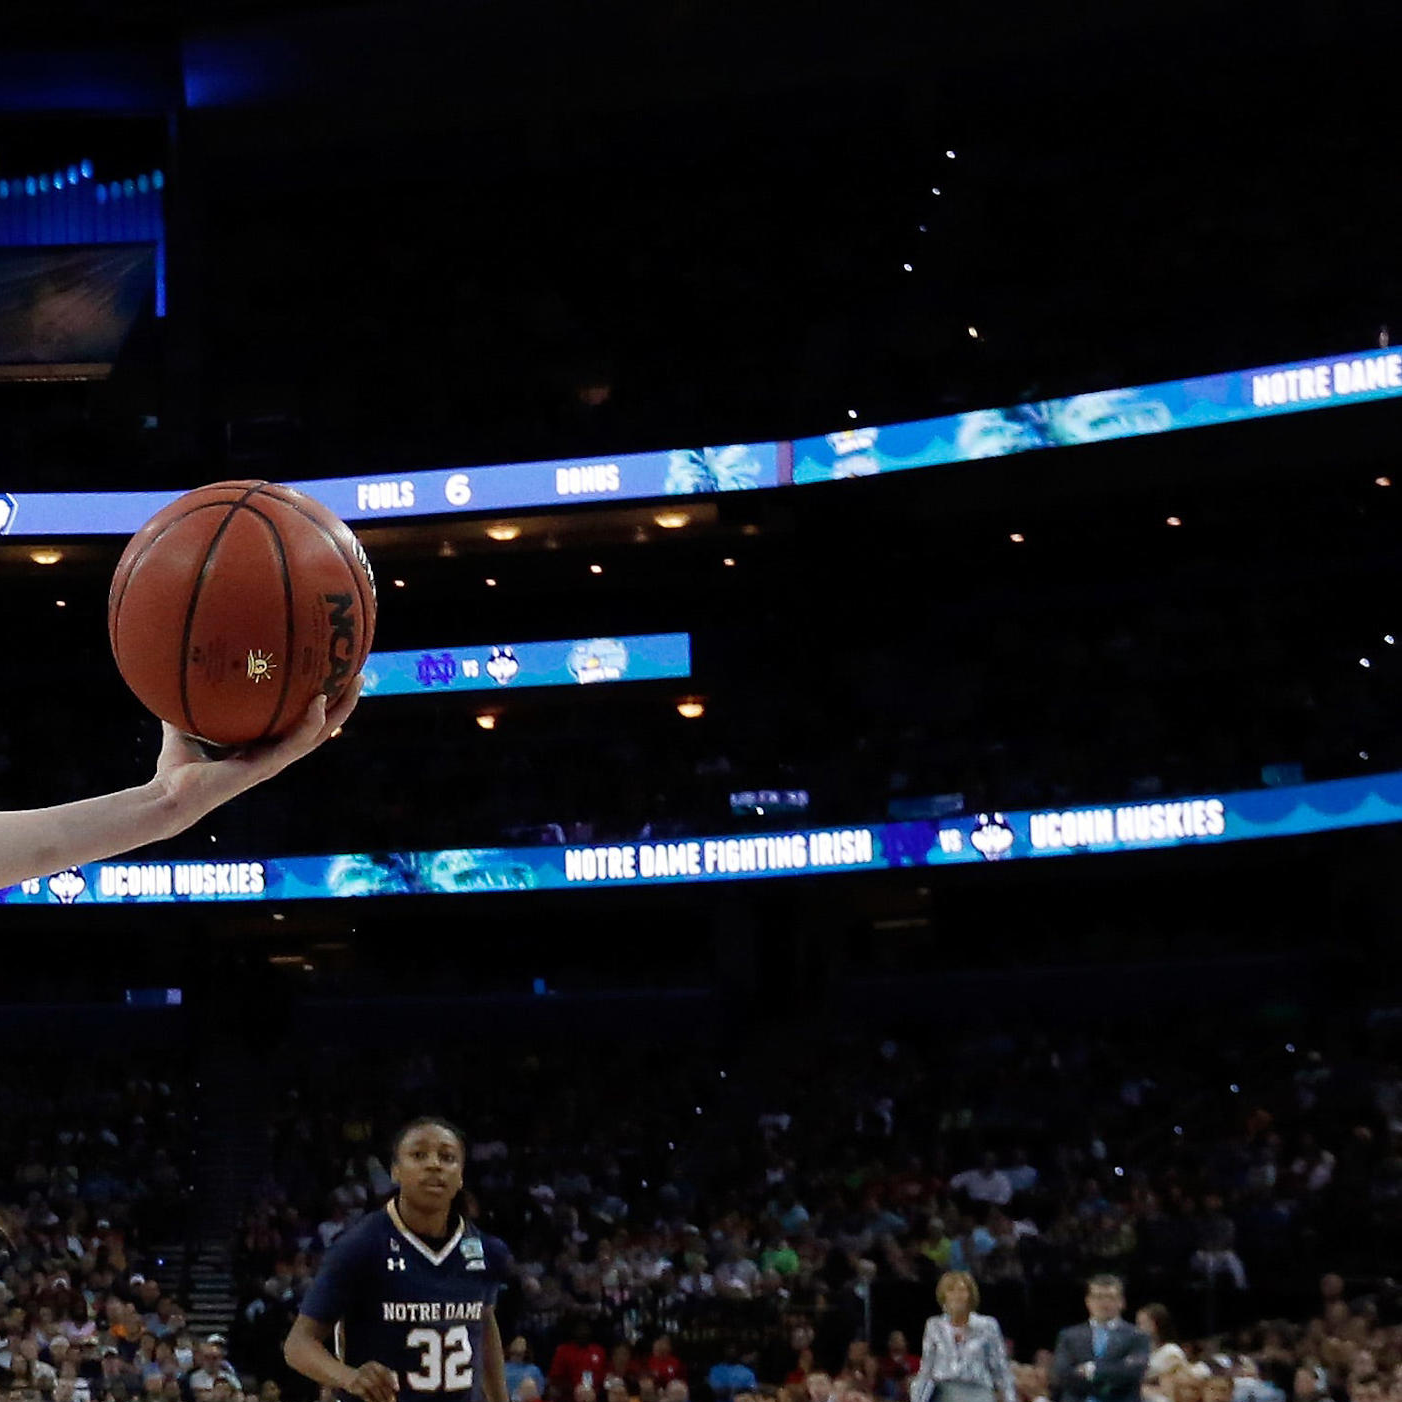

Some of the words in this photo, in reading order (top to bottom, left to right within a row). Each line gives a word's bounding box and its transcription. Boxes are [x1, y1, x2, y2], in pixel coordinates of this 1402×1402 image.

[1253, 364, 1331, 408] NOTRE
[1334, 354, 1402, 396] DAME
[357, 481, 415, 511] FOULS
[444, 474, 472, 507] 6
[564, 846, 636, 882] NOTRE
[639, 842, 701, 878] DAME
[703, 833, 807, 874] FIGHTING
[809, 828, 873, 866] IRISH
[938, 828, 963, 853] VS
[1030, 808, 1114, 849] UCONN
[1116, 799, 1226, 842] HUSKIES
[100, 865, 172, 896] UCONN
[174, 862, 265, 895] HUSKIES
[382, 1302, 441, 1321] NOTRE
[406, 1325, 474, 1392] 32
